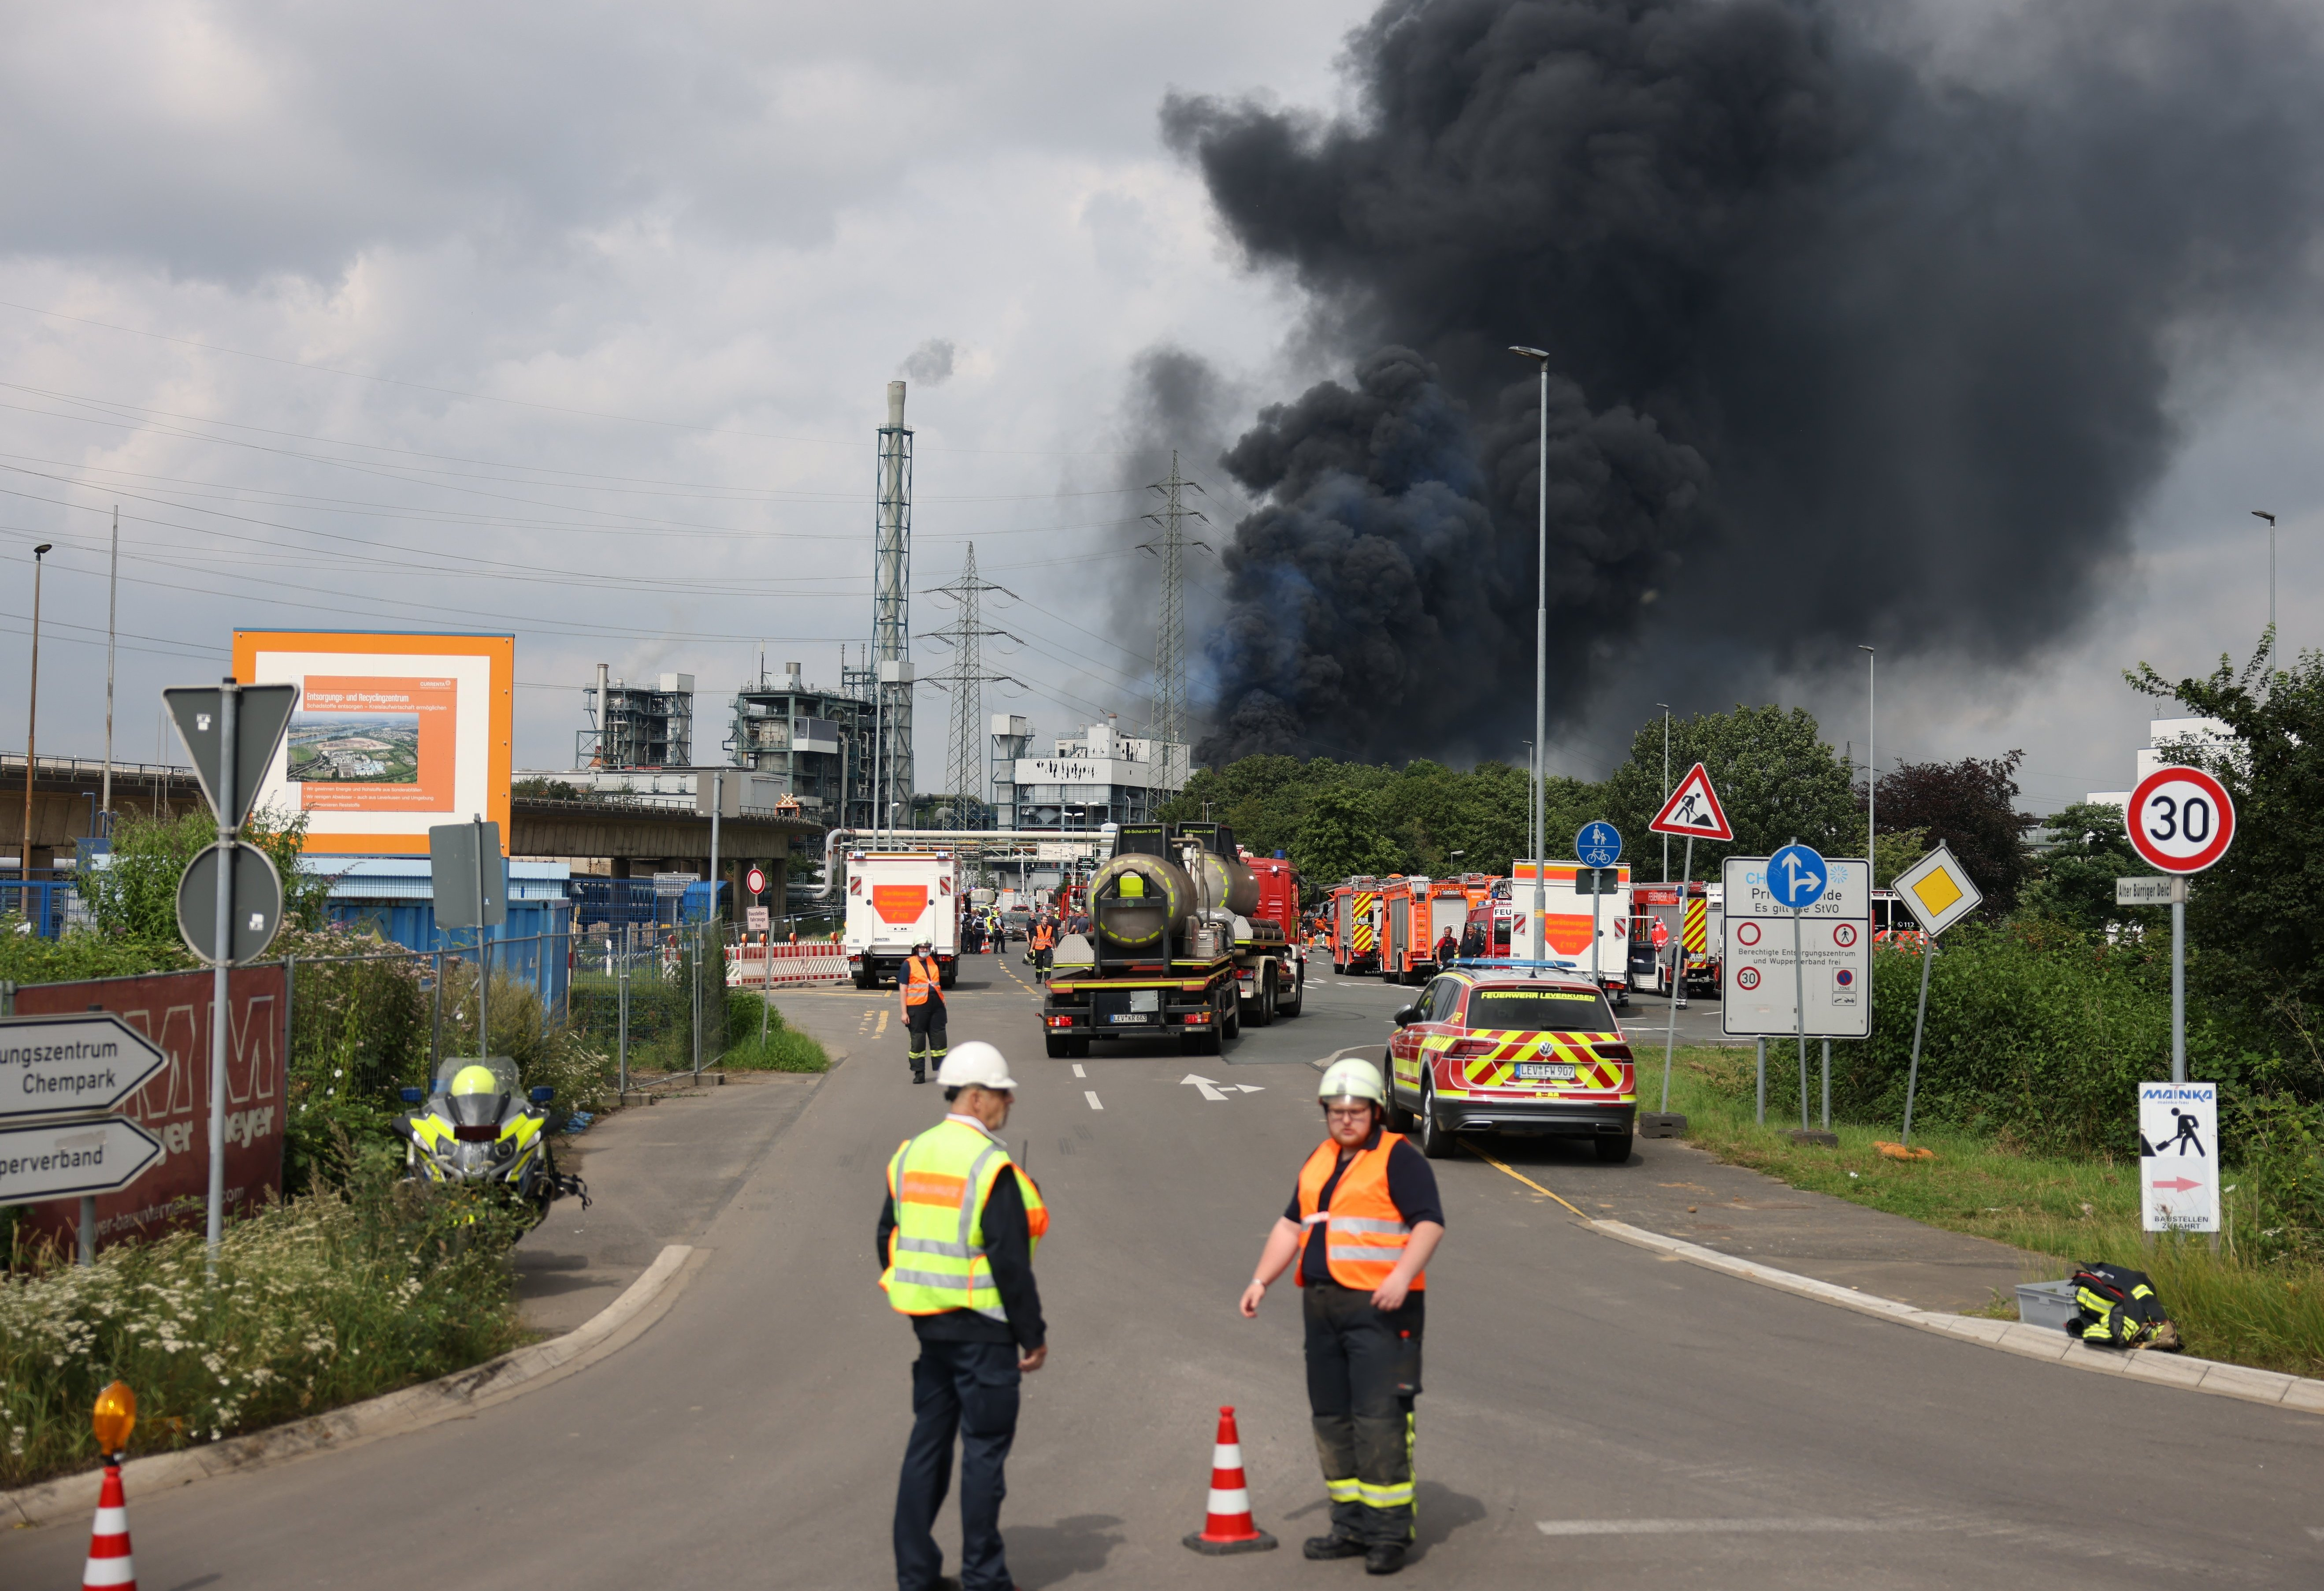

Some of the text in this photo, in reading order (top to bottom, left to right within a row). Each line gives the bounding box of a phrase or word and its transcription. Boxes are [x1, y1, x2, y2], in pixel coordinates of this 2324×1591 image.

[307, 692, 345, 703] Entsorgungs-
[359, 693, 409, 703] Recyclingzentrum
[2150, 796, 2210, 843] 30
[1648, 892, 1667, 901] FEUERWEHR
[2119, 884, 2132, 897] Alter
[2134, 883, 2156, 901] Bürriger
[1755, 903, 1767, 912] Es
[1815, 904, 1839, 913] StVO
[1547, 918, 1592, 927] Gerätewagen
[1545, 927, 1592, 936] Rettungsdiens
[1738, 948, 1856, 958] Berechtigte Entsrgungszentrum
[1741, 973, 1756, 984] 30
[1540, 993, 1596, 1002] LEVERKUSEN
[1522, 1065, 1538, 1075] LEV
[1544, 1066, 1556, 1075] FW
[1558, 1066, 1573, 1076] 907
[23, 1068, 116, 1096] Chempark
[2142, 1089, 2213, 1102] MAINKA
